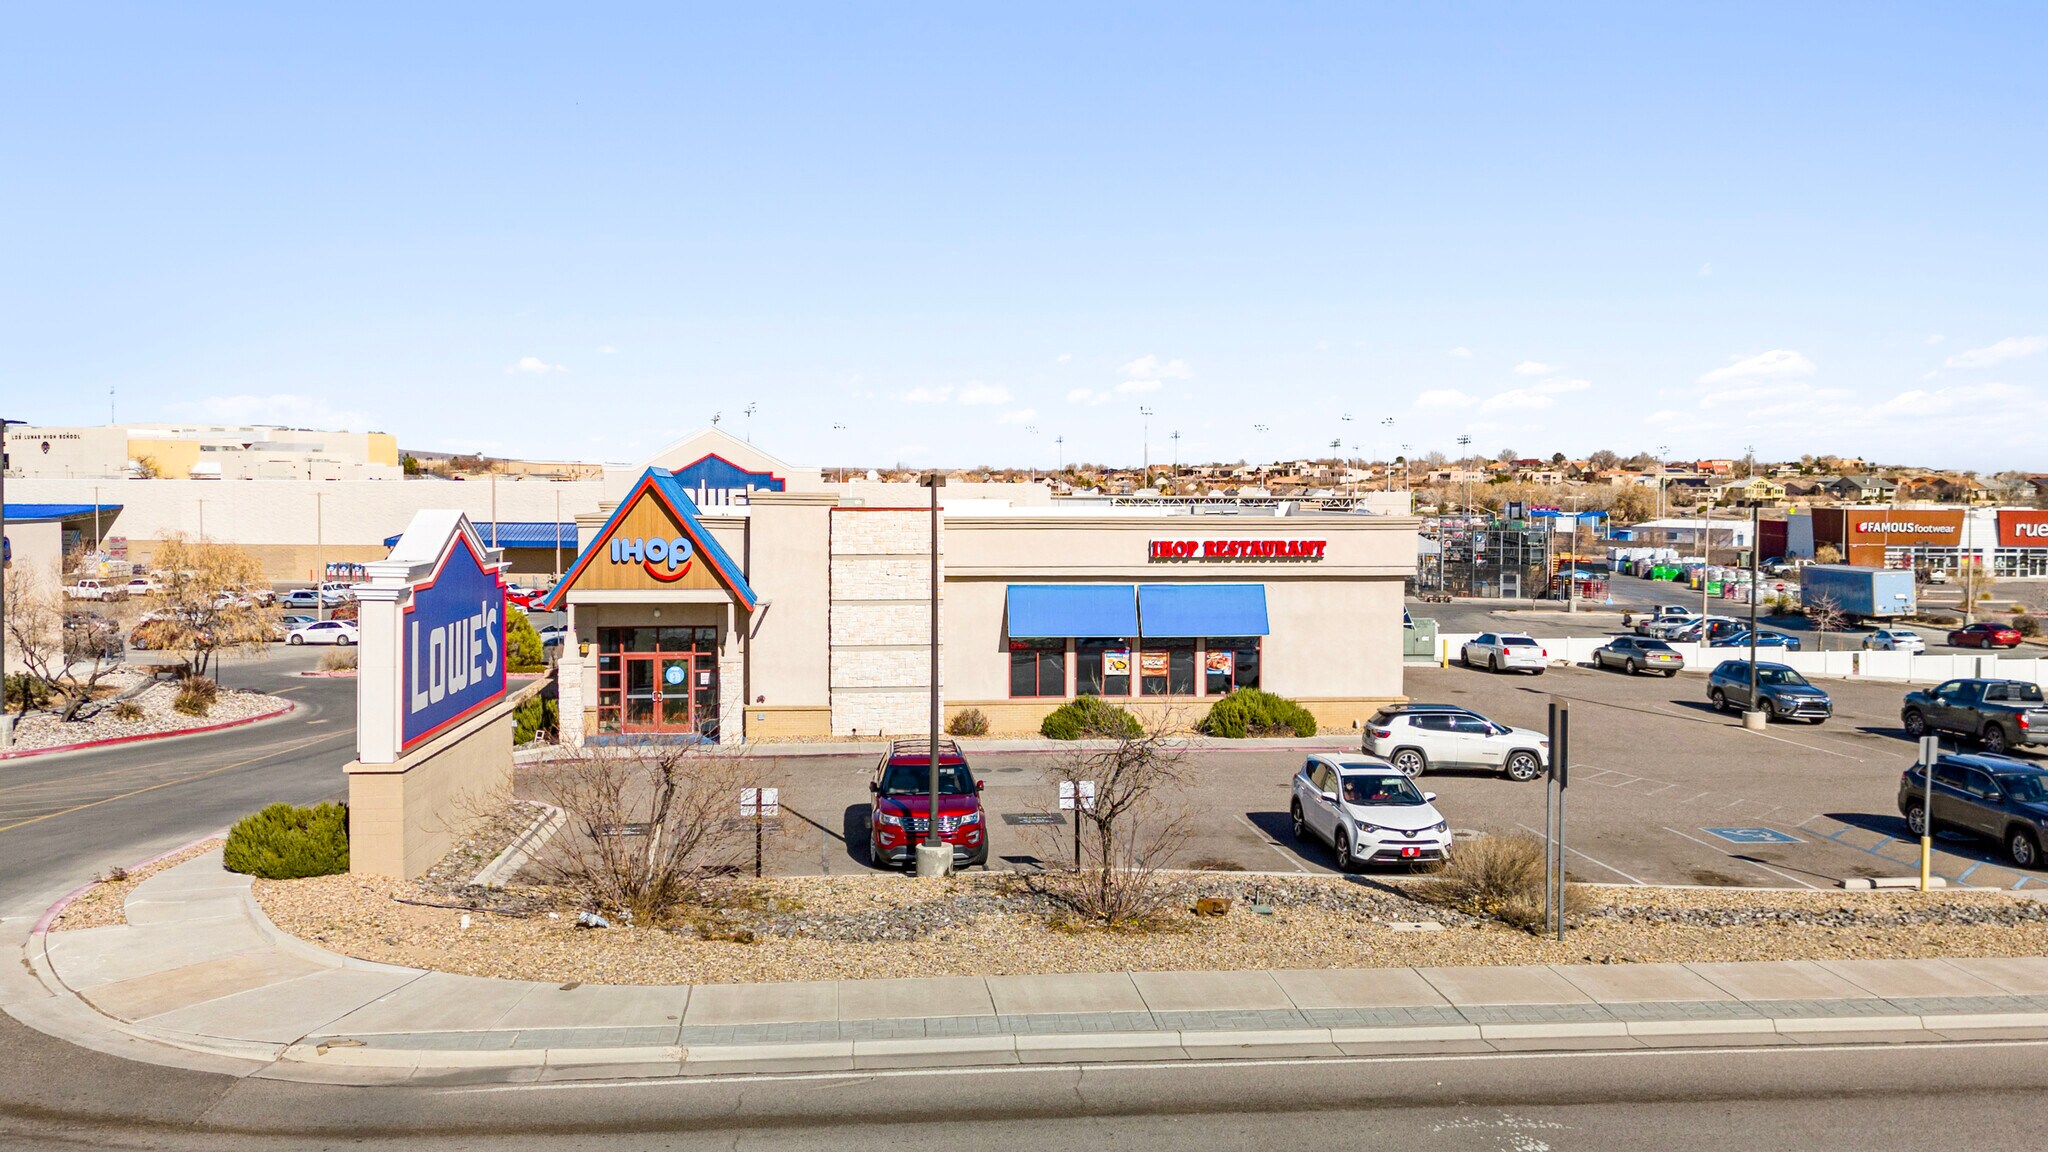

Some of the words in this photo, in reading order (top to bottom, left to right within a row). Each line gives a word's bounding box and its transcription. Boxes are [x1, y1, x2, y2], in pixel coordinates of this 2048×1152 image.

[1867, 522, 1914, 533] FAMOUS
[1914, 523, 1955, 533] footwear
[2015, 523, 2048, 537] rue
[1152, 540, 1199, 558] IHOP
[1203, 540, 1327, 558] RESTAURANT
